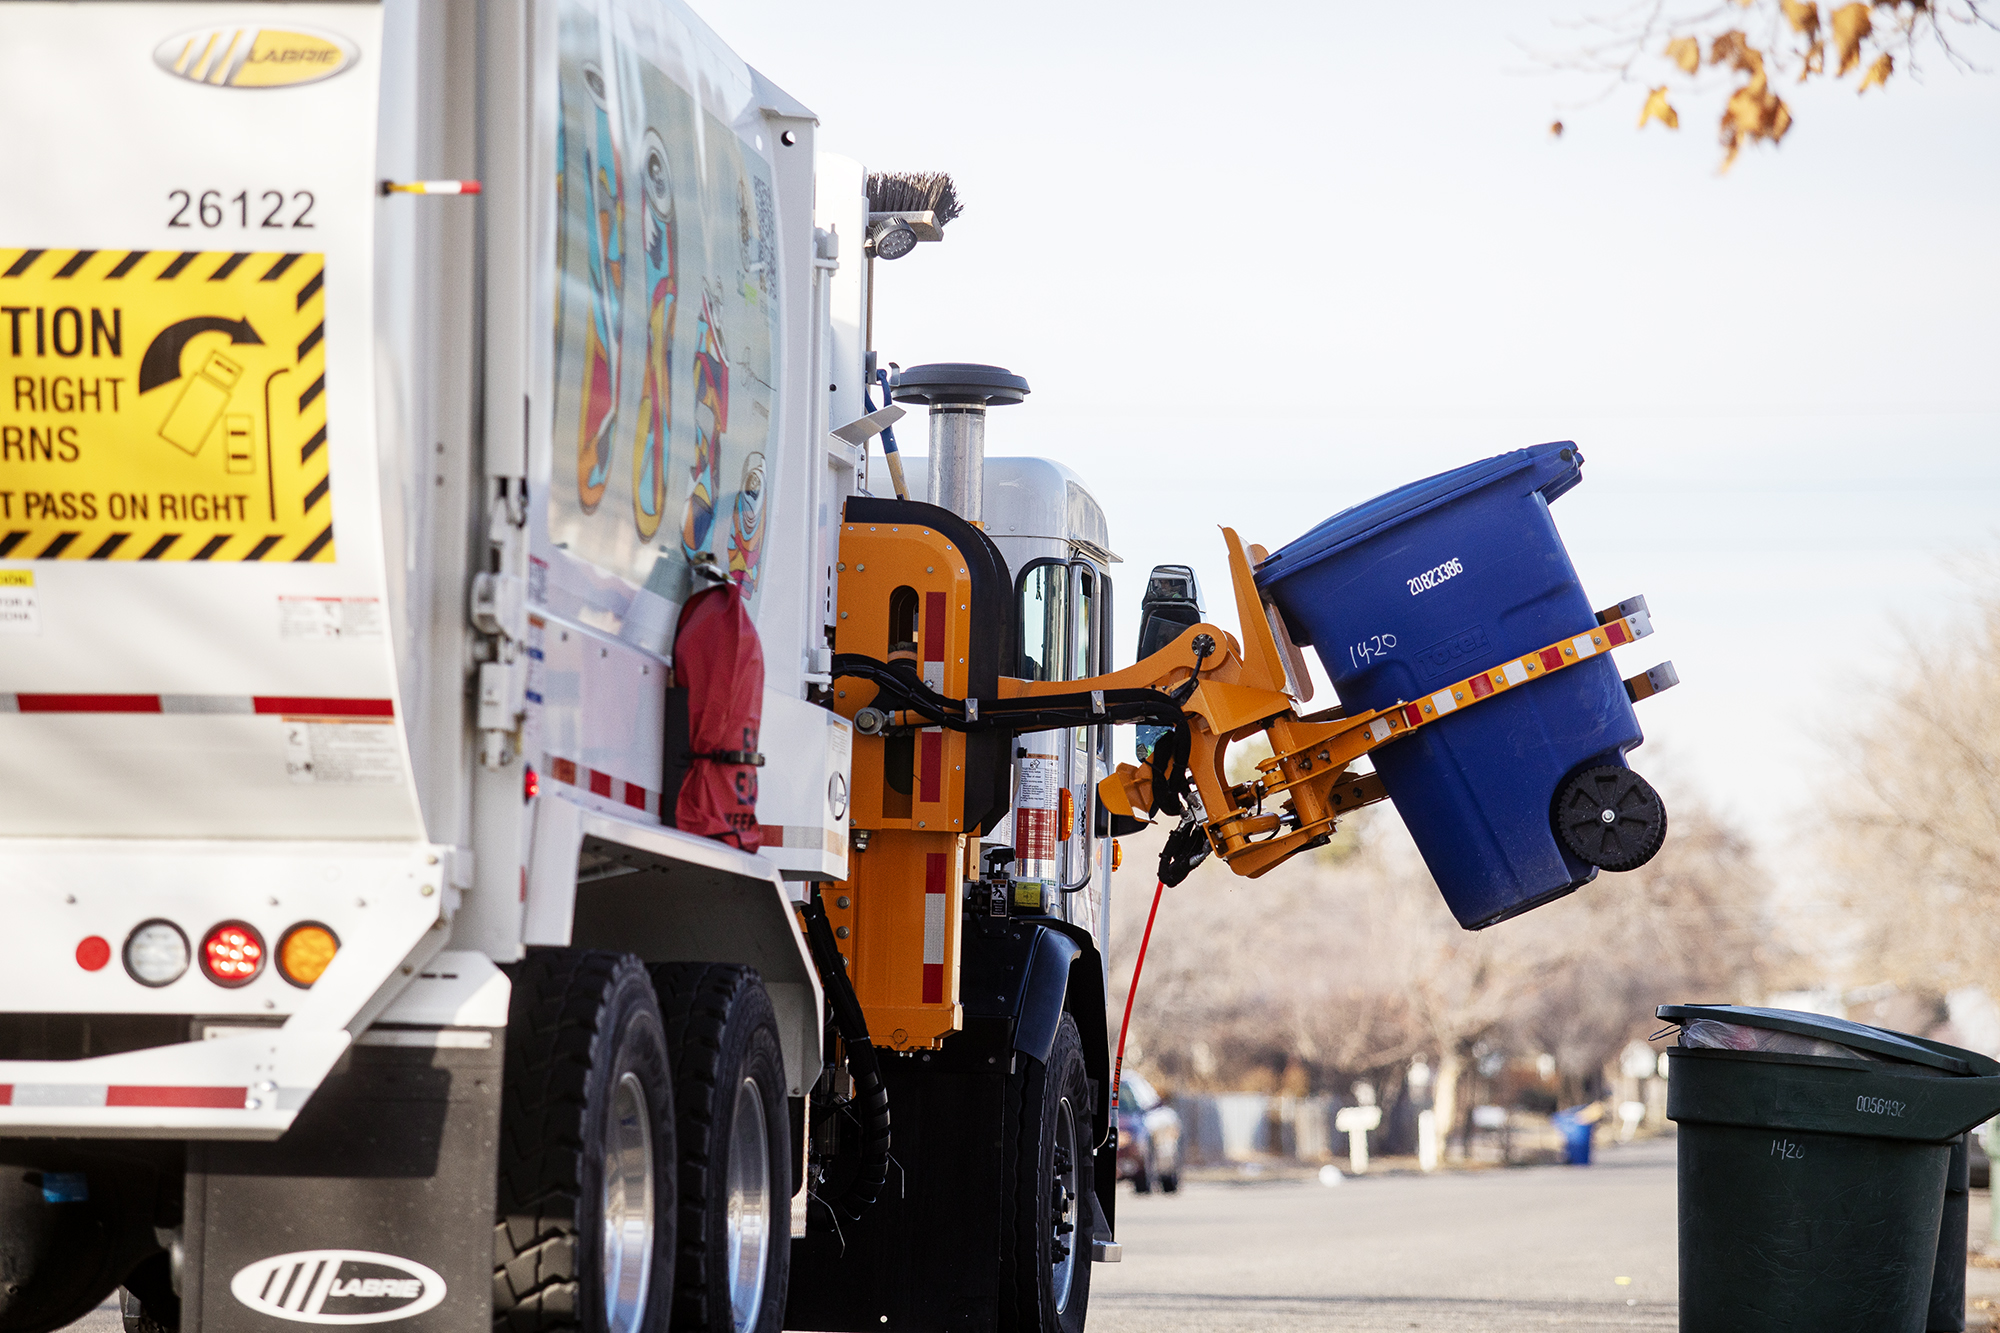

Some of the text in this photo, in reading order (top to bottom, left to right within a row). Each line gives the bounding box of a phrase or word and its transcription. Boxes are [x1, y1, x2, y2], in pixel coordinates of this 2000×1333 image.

[246, 46, 337, 65] LABRIE
[167, 190, 315, 228] 26122
[0, 306, 123, 358] TION
[14, 375, 125, 413] RIGHT
[2, 426, 80, 463] RNS
[25, 492, 98, 520] PASS
[109, 494, 149, 521] ON
[160, 495, 250, 522] RIGHT
[1407, 557, 1463, 596] 20823386
[1350, 633, 1397, 668] 1420
[1856, 1095, 1906, 1118] 0056492
[1770, 1139, 1805, 1160] 1420
[329, 1278, 422, 1298] LABRIE
